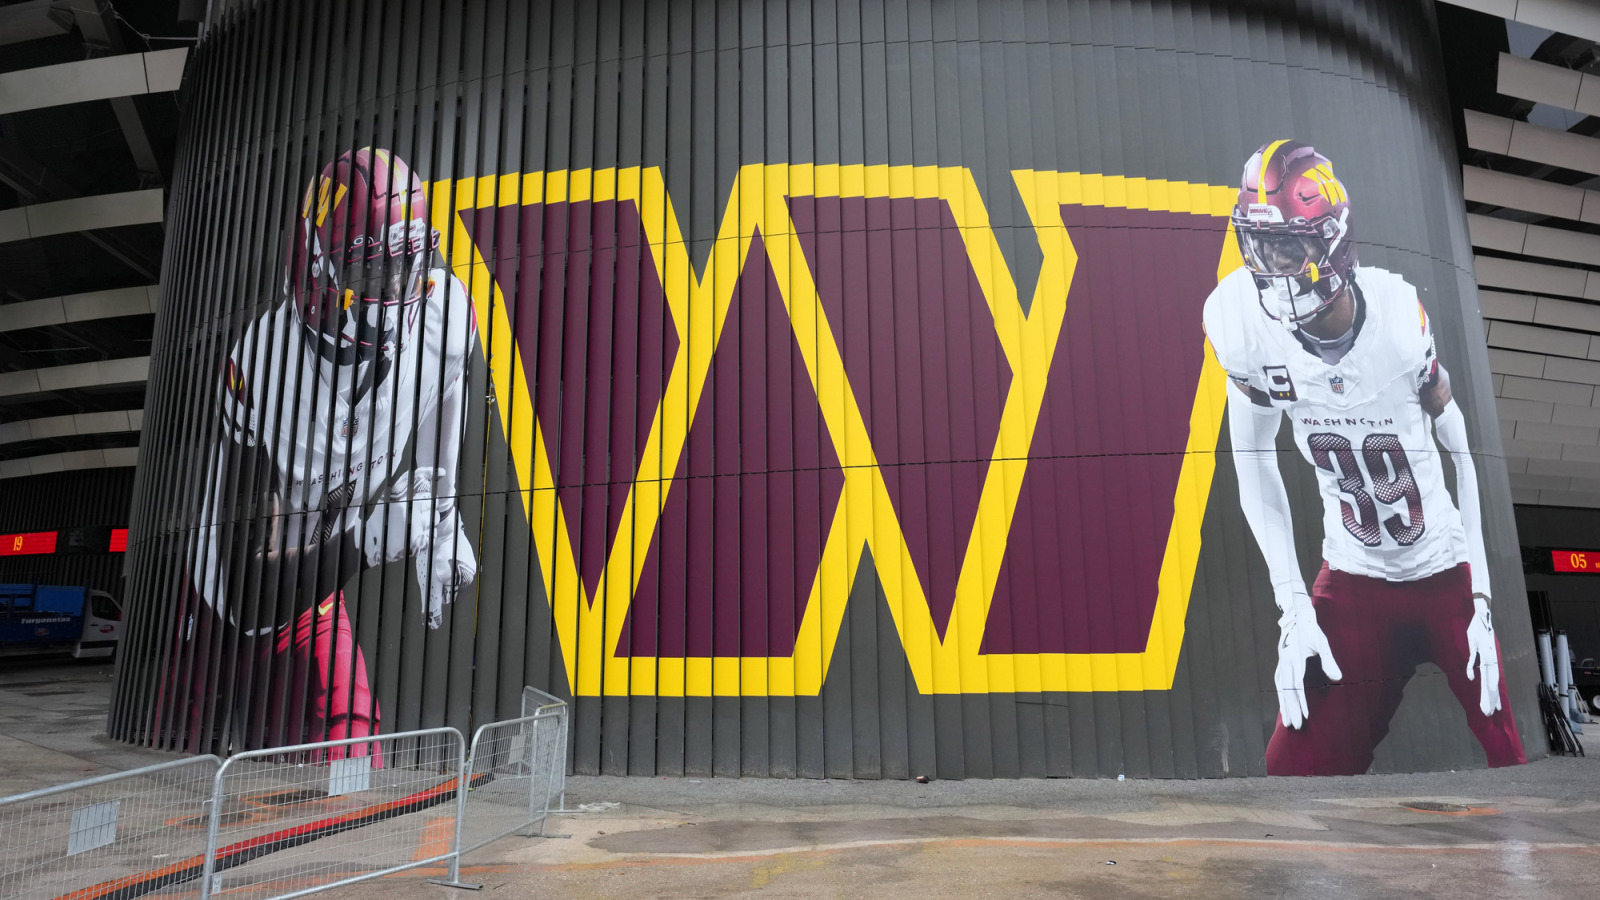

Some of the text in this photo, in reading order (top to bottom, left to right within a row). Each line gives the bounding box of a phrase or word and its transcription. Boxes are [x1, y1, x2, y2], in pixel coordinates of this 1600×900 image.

[1307, 432, 1425, 547] 39
[13, 536, 23, 551] 19
[1570, 553, 1587, 569] 05
